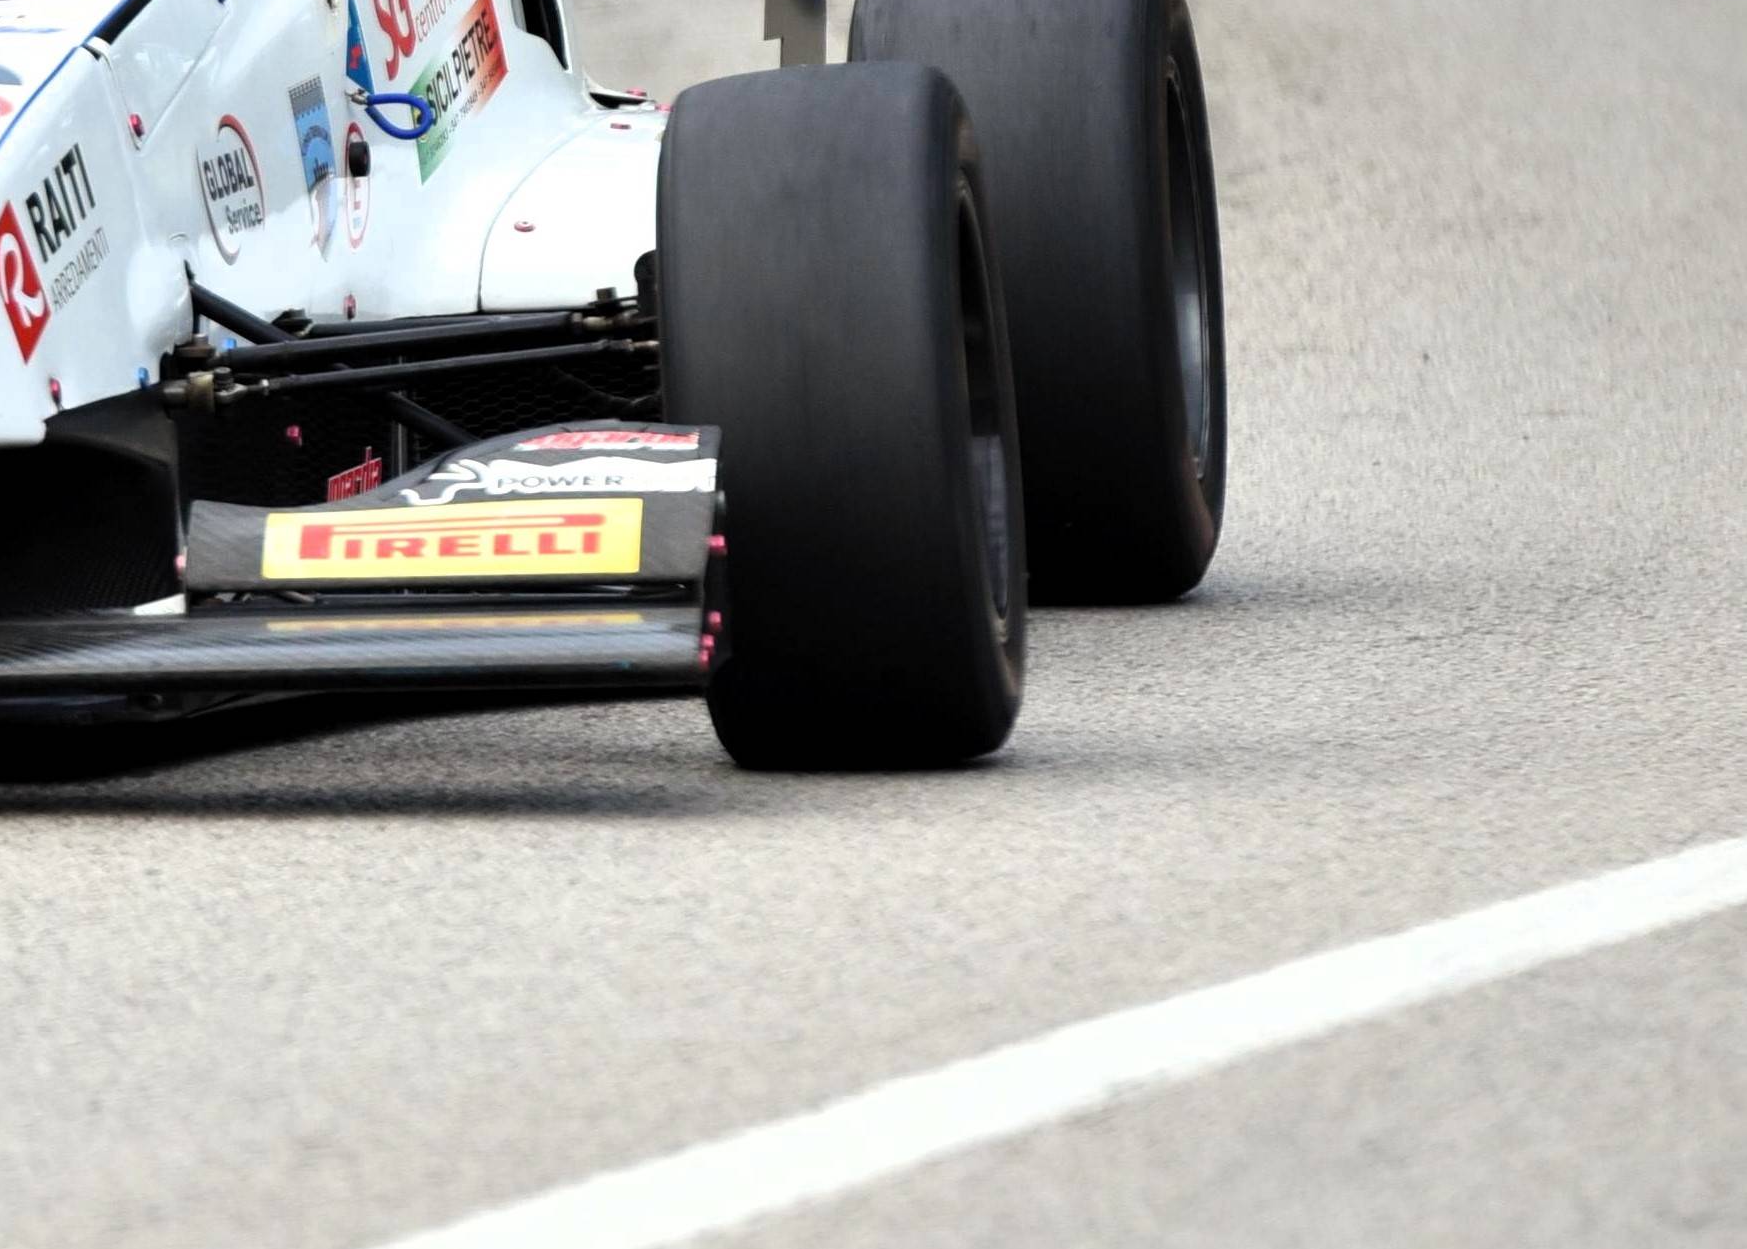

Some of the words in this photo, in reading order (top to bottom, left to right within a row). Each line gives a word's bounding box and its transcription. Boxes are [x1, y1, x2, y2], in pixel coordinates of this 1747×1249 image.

[425, 6, 496, 127] SICILPIETRE
[25, 143, 96, 263] RAITI
[201, 148, 255, 202] GLOBAL
[224, 198, 264, 235] Service
[51, 228, 111, 311] ARREDAMENTI
[300, 512, 608, 561] PIRELLI
